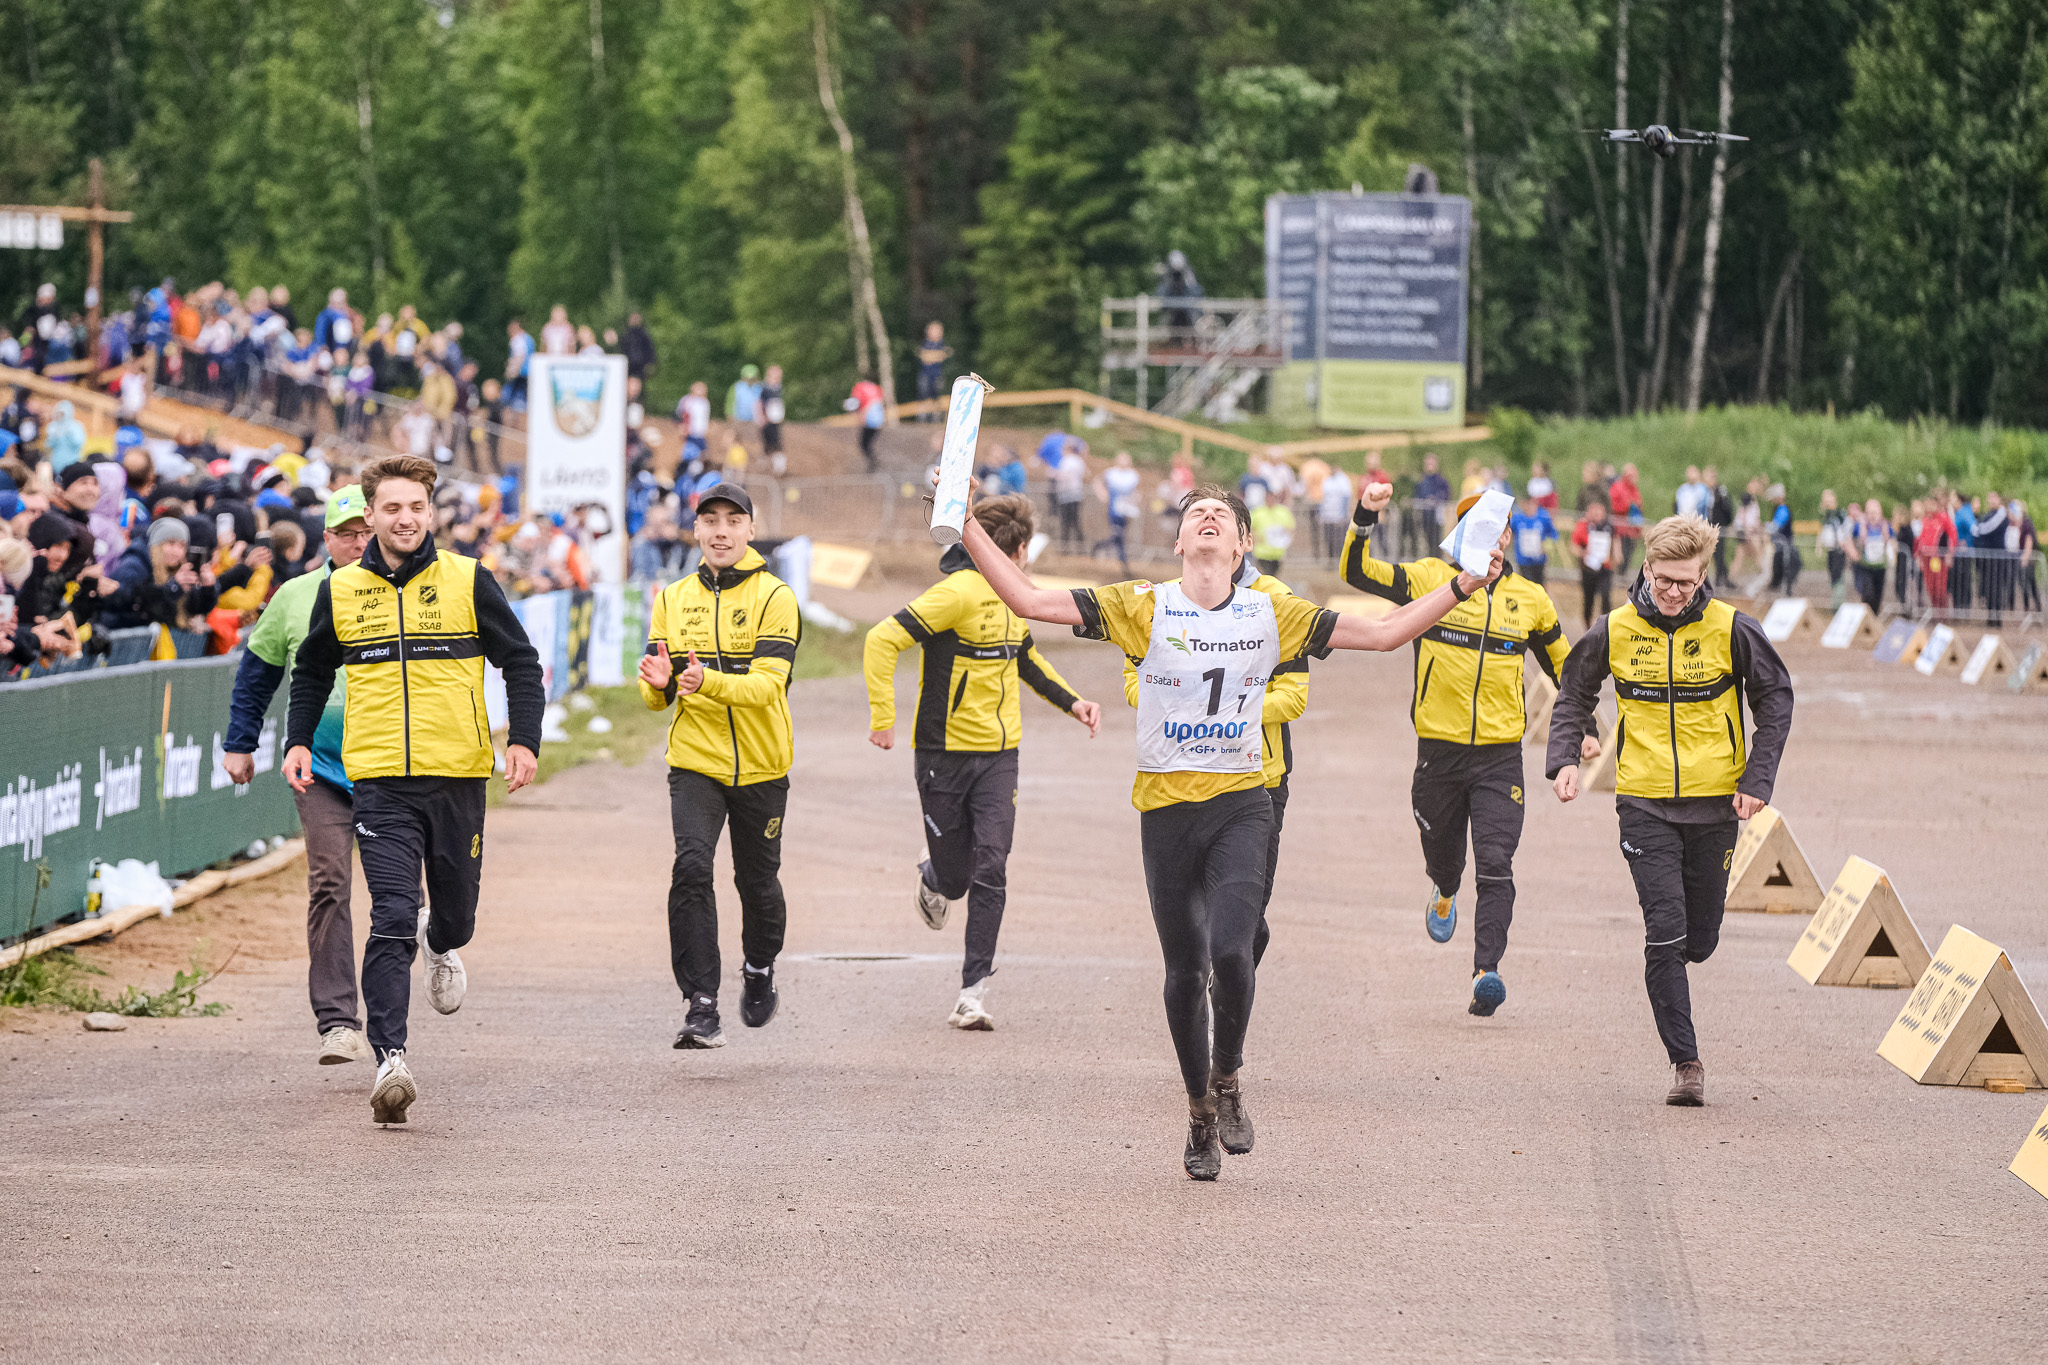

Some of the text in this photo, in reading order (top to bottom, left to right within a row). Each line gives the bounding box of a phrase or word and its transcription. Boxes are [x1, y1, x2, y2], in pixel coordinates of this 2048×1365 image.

[354, 586, 387, 597] TRIMTEX
[418, 609, 441, 619] viati
[418, 621, 442, 631] SSAB
[729, 630, 749, 640] viati
[1630, 635, 1660, 644] TRIMTEX
[731, 642, 751, 650] SSAB
[1189, 638, 1264, 652] Tornator
[1682, 660, 1704, 670] viati
[1152, 675, 1172, 687] Sata
[1683, 672, 1704, 680] SSAB
[1202, 667, 1225, 717] 1
[1237, 693, 1247, 713] 7
[1164, 721, 1248, 744] uponor
[1220, 746, 1242, 754] brand
[1908, 973, 1968, 1031] GRAND GRAND
